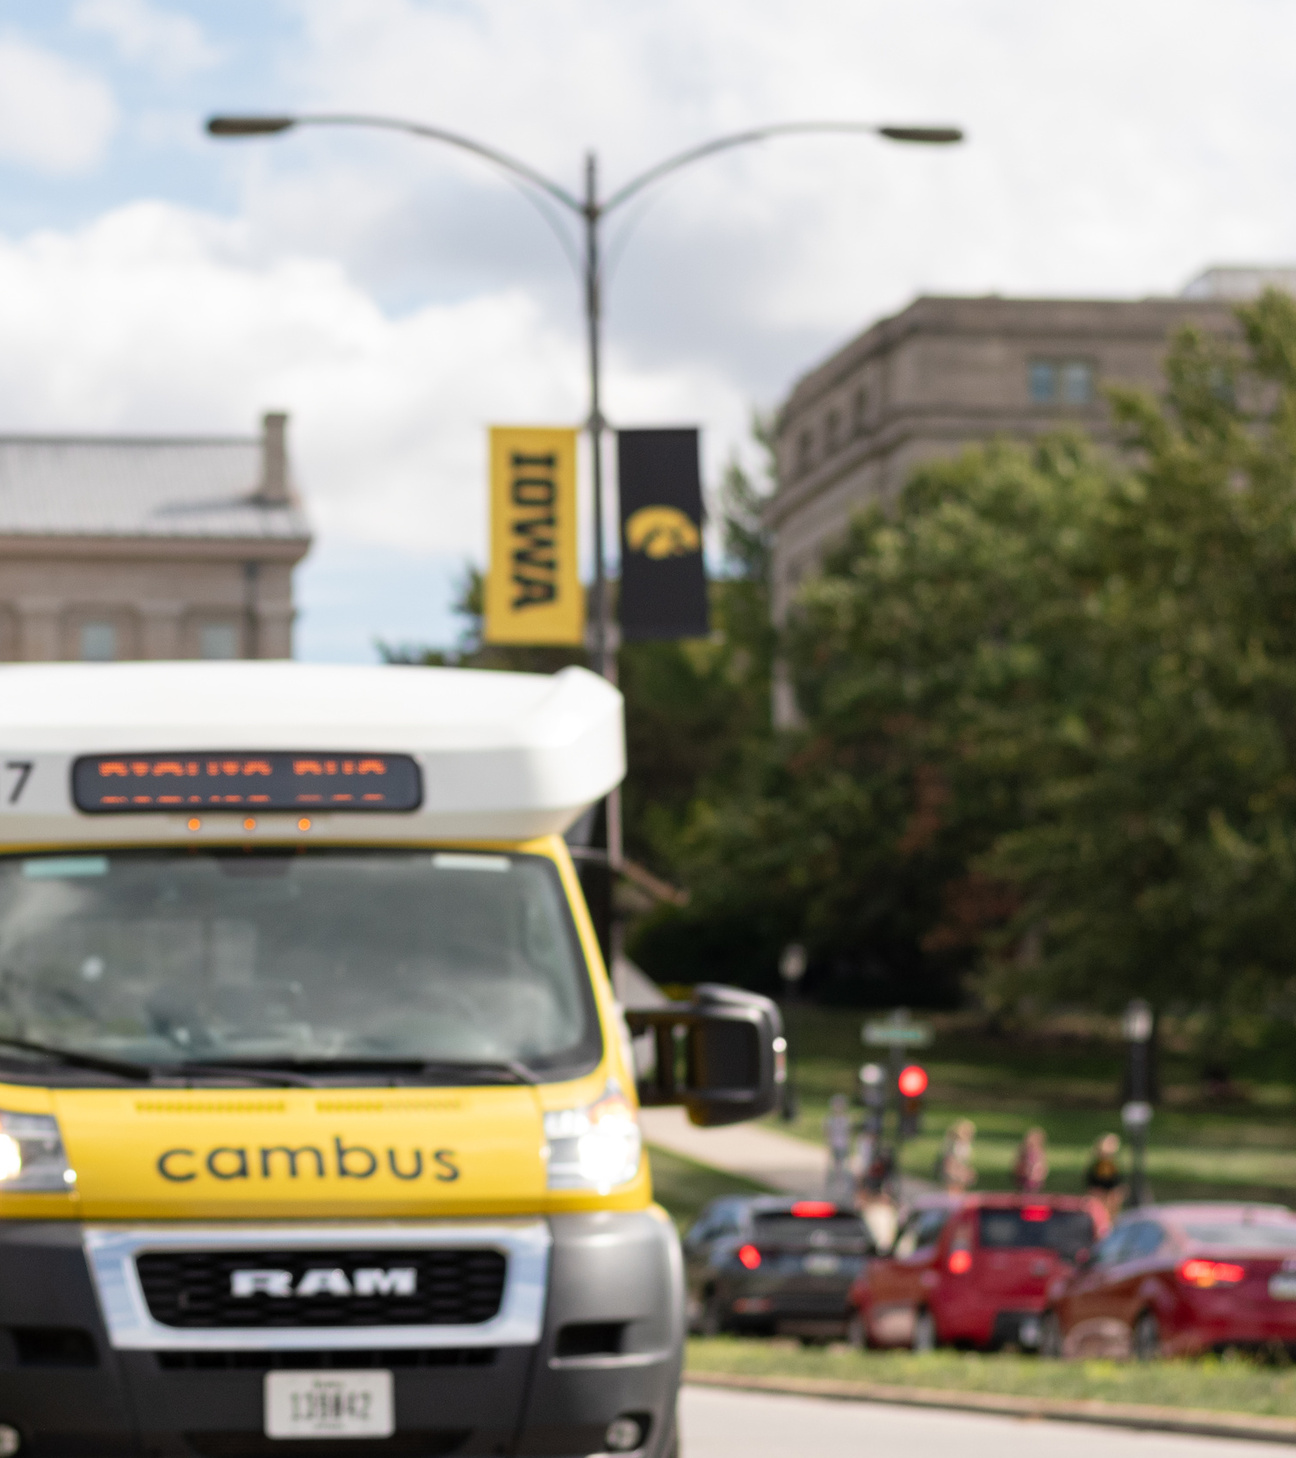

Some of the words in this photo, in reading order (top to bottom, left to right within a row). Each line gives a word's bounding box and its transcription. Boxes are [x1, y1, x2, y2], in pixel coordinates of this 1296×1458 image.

[510, 453, 556, 611] IOWA
[157, 1135, 461, 1182] cambus
[230, 1267, 417, 1298] RAM
